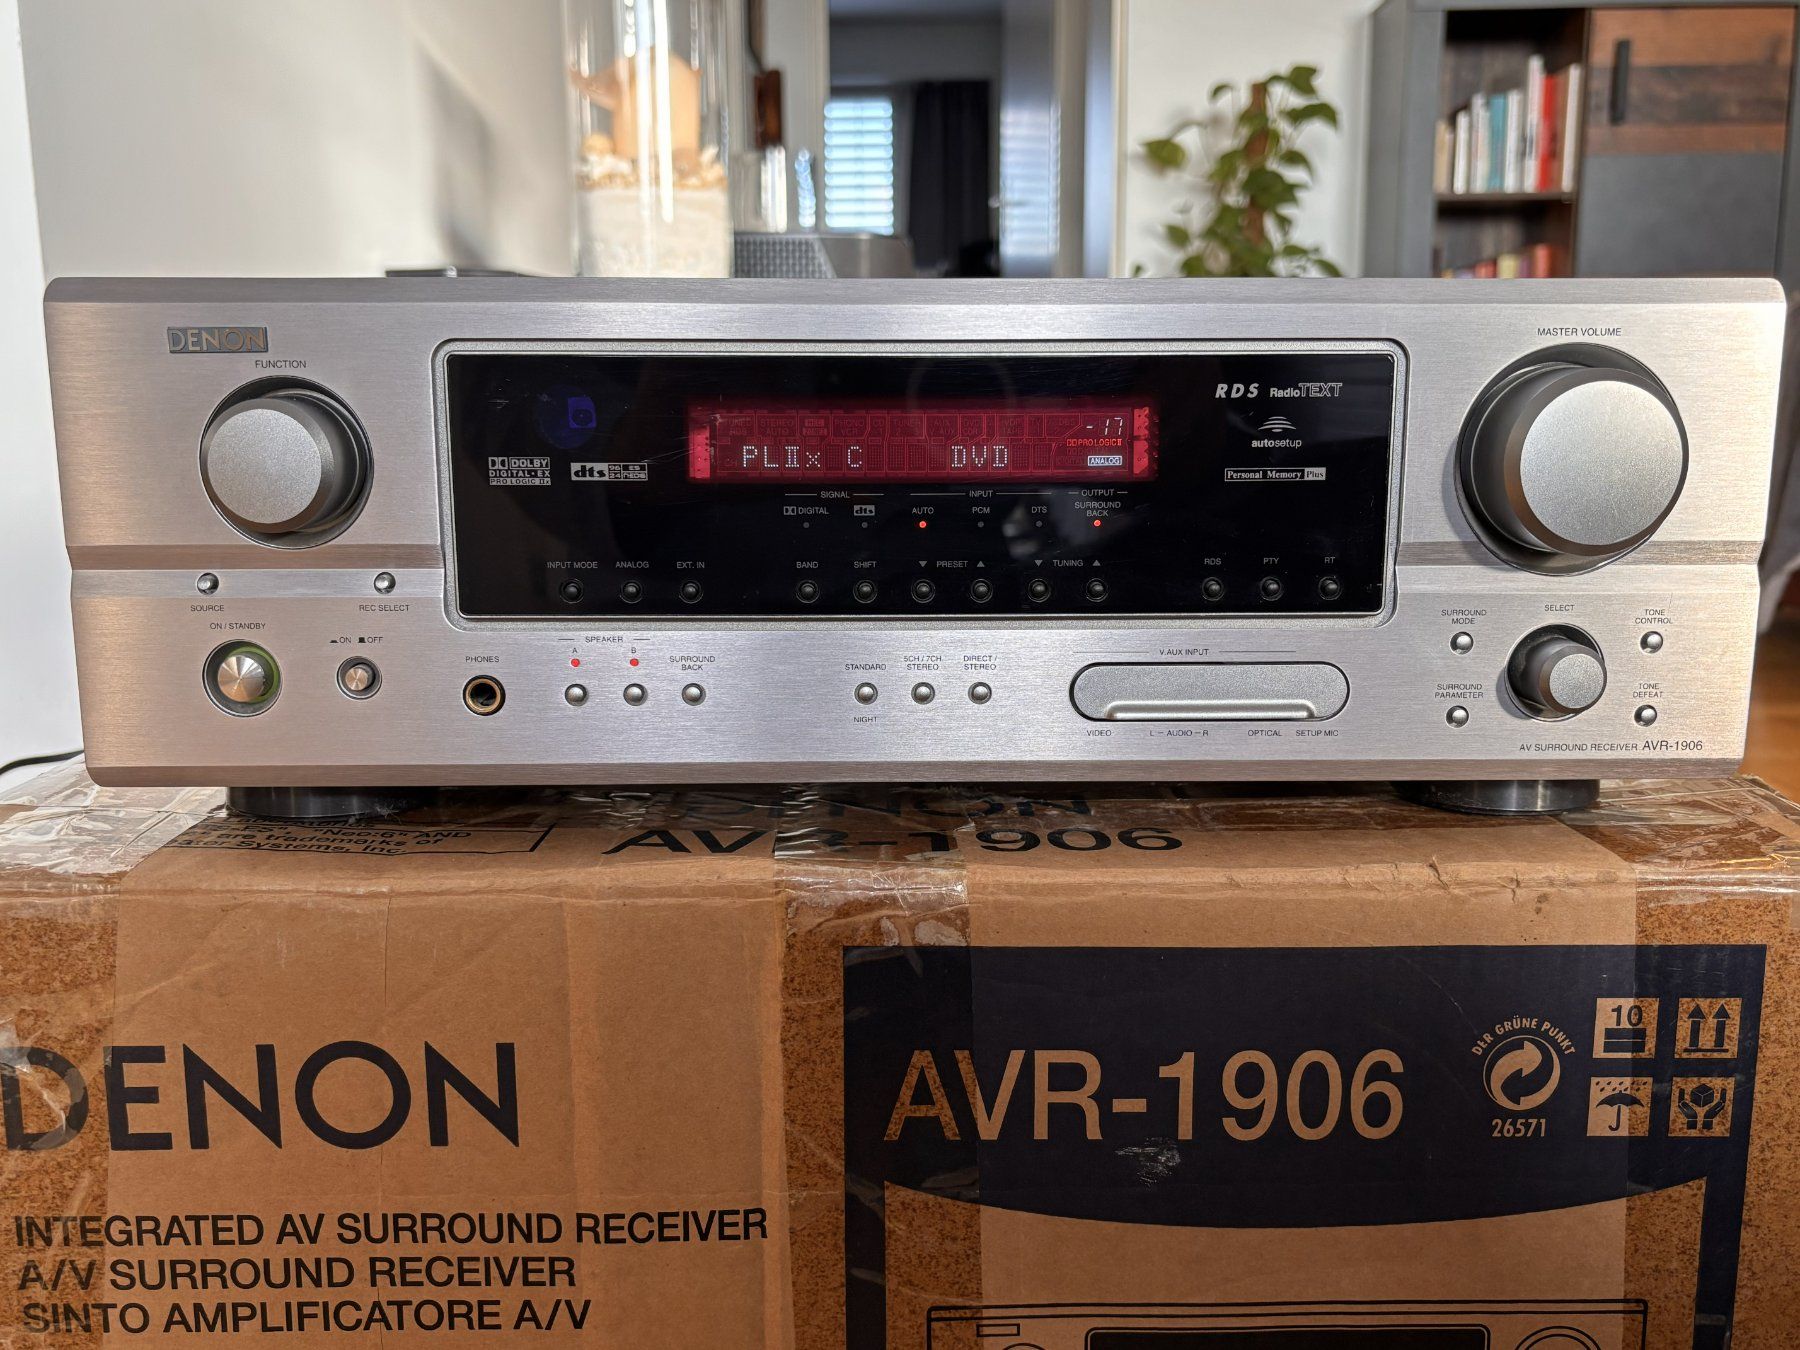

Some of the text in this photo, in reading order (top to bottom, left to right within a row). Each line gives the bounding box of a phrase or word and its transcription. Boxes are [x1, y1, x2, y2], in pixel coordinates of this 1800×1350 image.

[1537, 328, 1622, 337] MASTER VOLUME
[168, 328, 266, 350] DENON
[255, 360, 307, 369] FUNCTION
[1215, 383, 1260, 399] RDS
[1079, 439, 1094, 447] PRO
[1095, 439, 1116, 447] LOGIC
[848, 446, 862, 467] C
[951, 446, 1008, 467] DVD
[511, 459, 549, 468] DOLBY
[1090, 457, 1120, 465] ANALOG
[573, 465, 606, 478] dts
[1227, 470, 1324, 480] Personal Memory Plus
[969, 490, 993, 498] INPUT
[1075, 501, 1121, 509] SURROUND
[1031, 506, 1047, 514] DTS
[1086, 509, 1109, 517] BACK
[796, 561, 818, 569] BAND
[1053, 559, 1083, 567] TUNING
[1263, 557, 1279, 565] PTY
[190, 604, 225, 612] SOURCE
[359, 604, 410, 612] REC SELECT
[1544, 604, 1575, 612] SELECT
[210, 622, 223, 630] ON
[228, 622, 266, 630] STANDBY
[339, 636, 352, 644] ON
[1185, 648, 1210, 656] INPUT
[465, 655, 499, 663] PHONES
[669, 655, 715, 663] SURROUND
[845, 663, 887, 671] STANDARD
[1436, 683, 1483, 691] SURROUND
[1434, 691, 1484, 699] PARAMETER
[1086, 729, 1112, 737] VIDEO
[1166, 729, 1193, 737] AUDIO
[1247, 729, 1282, 737] OPTICAL
[1295, 729, 1339, 737] SETUP MIC
[1519, 740, 1703, 751] AV SURROUND RECEIVER AVR-1906
[413, 831, 472, 839] AND
[266, 834, 407, 847] trademarks
[1611, 1004, 1643, 1027] 10
[1471, 1014, 1576, 1056] DER GRÜNE PUNKT
[0, 1040, 520, 1151] DENON
[883, 1048, 1405, 1142] AVR-1906
[1491, 1118, 1546, 1138] 26571
[14, 1206, 768, 1247] INTEGRATED AV SURROUND RECEIVER
[18, 1256, 576, 1291] A/V SURROUND RECEIVER
[23, 1297, 592, 1334] SINTO AMPLIFICATORE A/V
